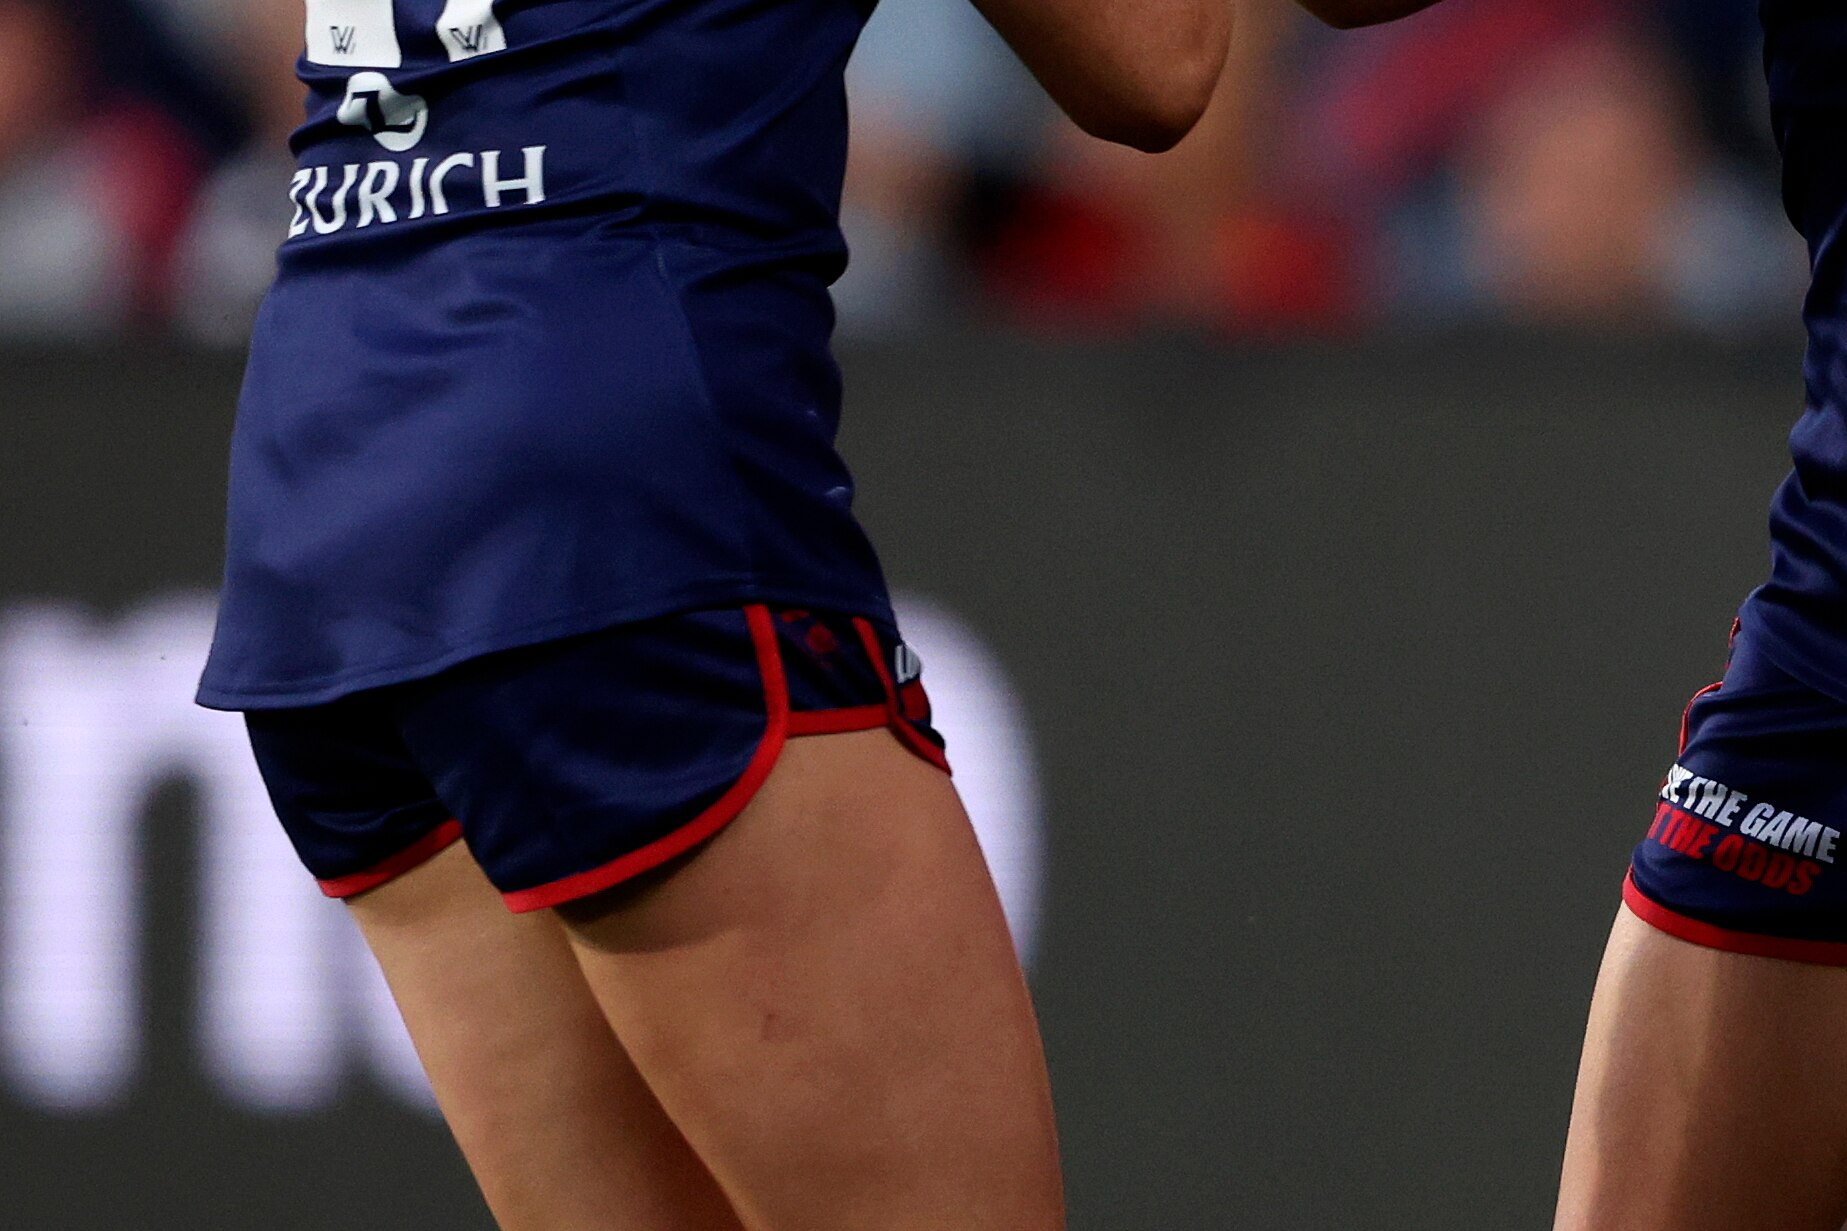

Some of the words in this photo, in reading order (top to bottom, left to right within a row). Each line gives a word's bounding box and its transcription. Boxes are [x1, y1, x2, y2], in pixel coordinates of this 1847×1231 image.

[288, 145, 547, 239] ZURICH
[1683, 775, 1748, 828] THE
[1739, 802, 1841, 864] GAME
[1712, 833, 1822, 896] ODDS
